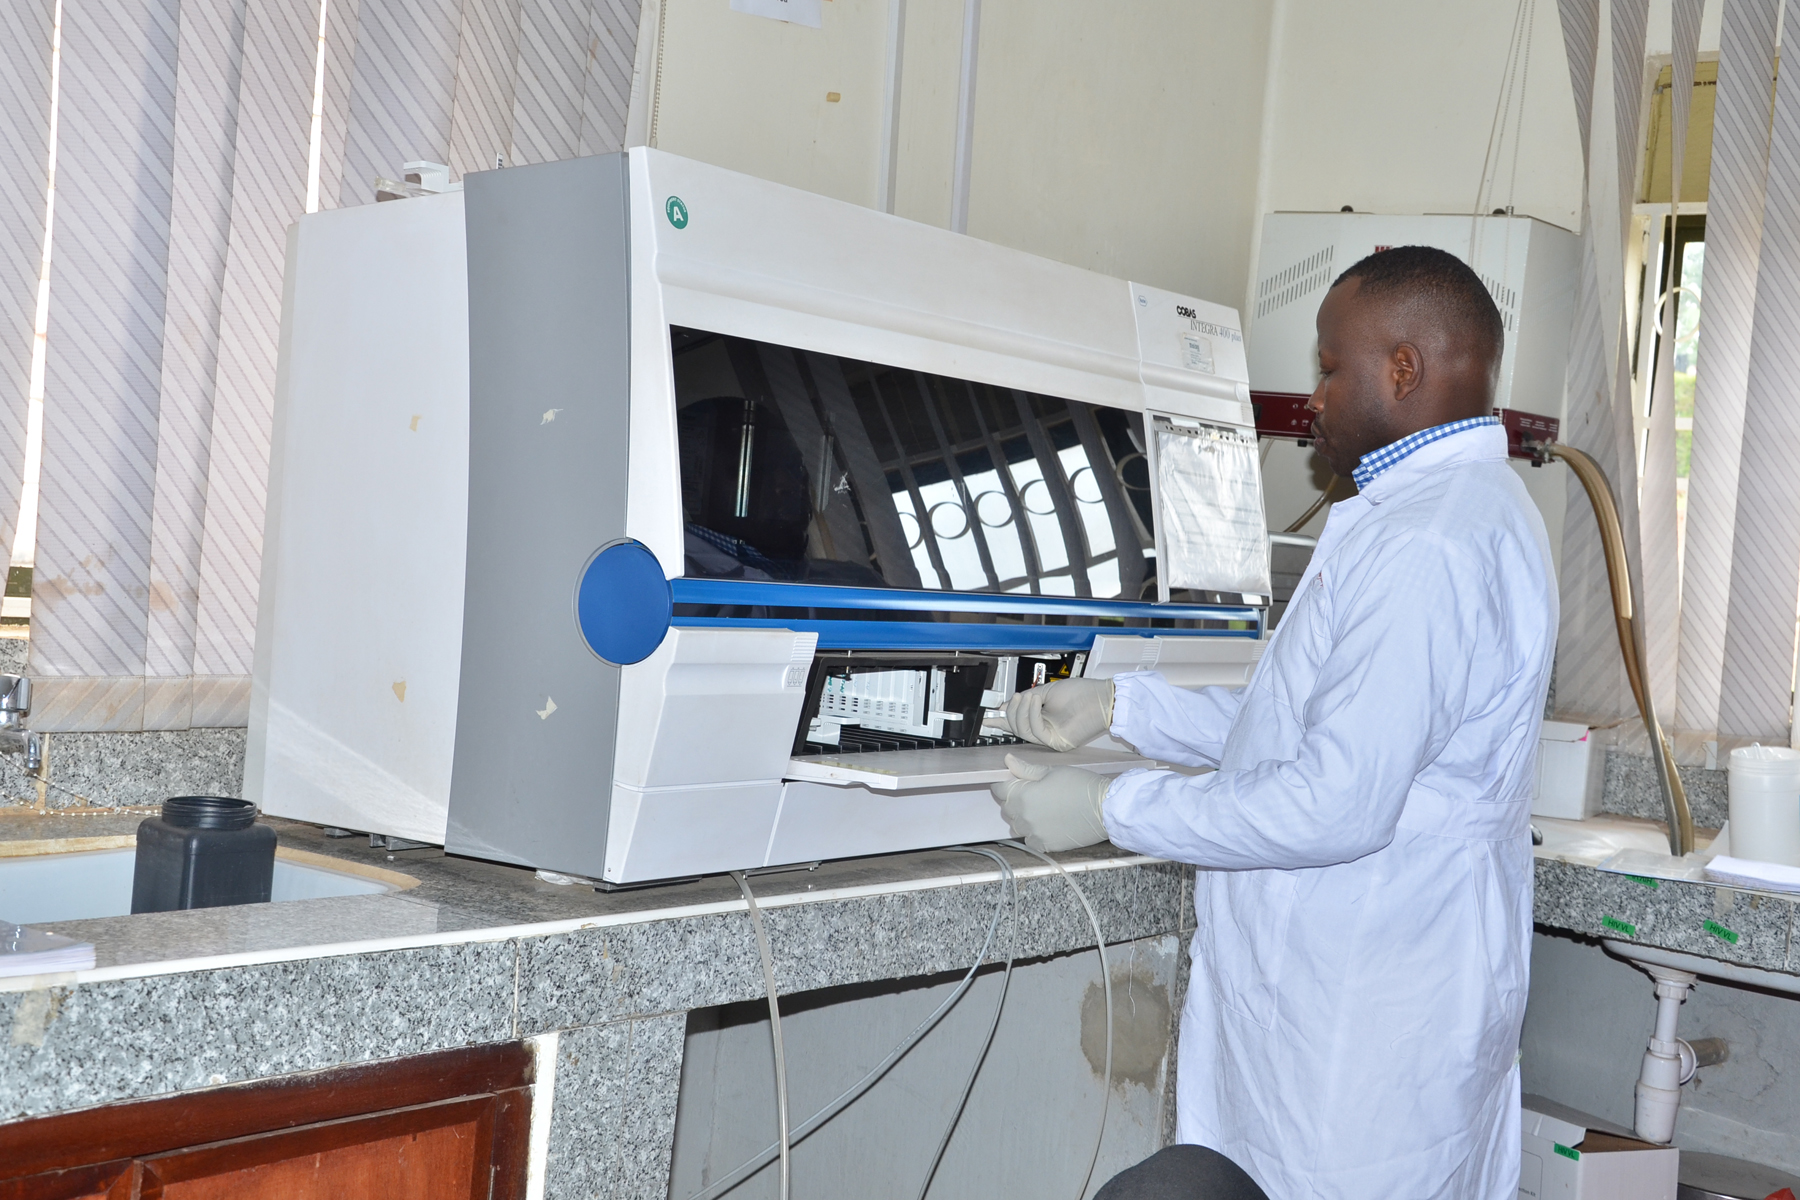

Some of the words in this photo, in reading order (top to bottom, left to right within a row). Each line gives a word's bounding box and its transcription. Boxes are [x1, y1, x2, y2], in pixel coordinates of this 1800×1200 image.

[673, 206, 684, 222] A
[1176, 305, 1197, 318] COBAS
[1190, 319, 1219, 337] INTEGRA
[1219, 326, 1231, 340] 400
[1607, 919, 1621, 929] HIV
[1621, 923, 1630, 933] VL
[1709, 923, 1723, 935] HIV
[1723, 930, 1732, 941] VL
